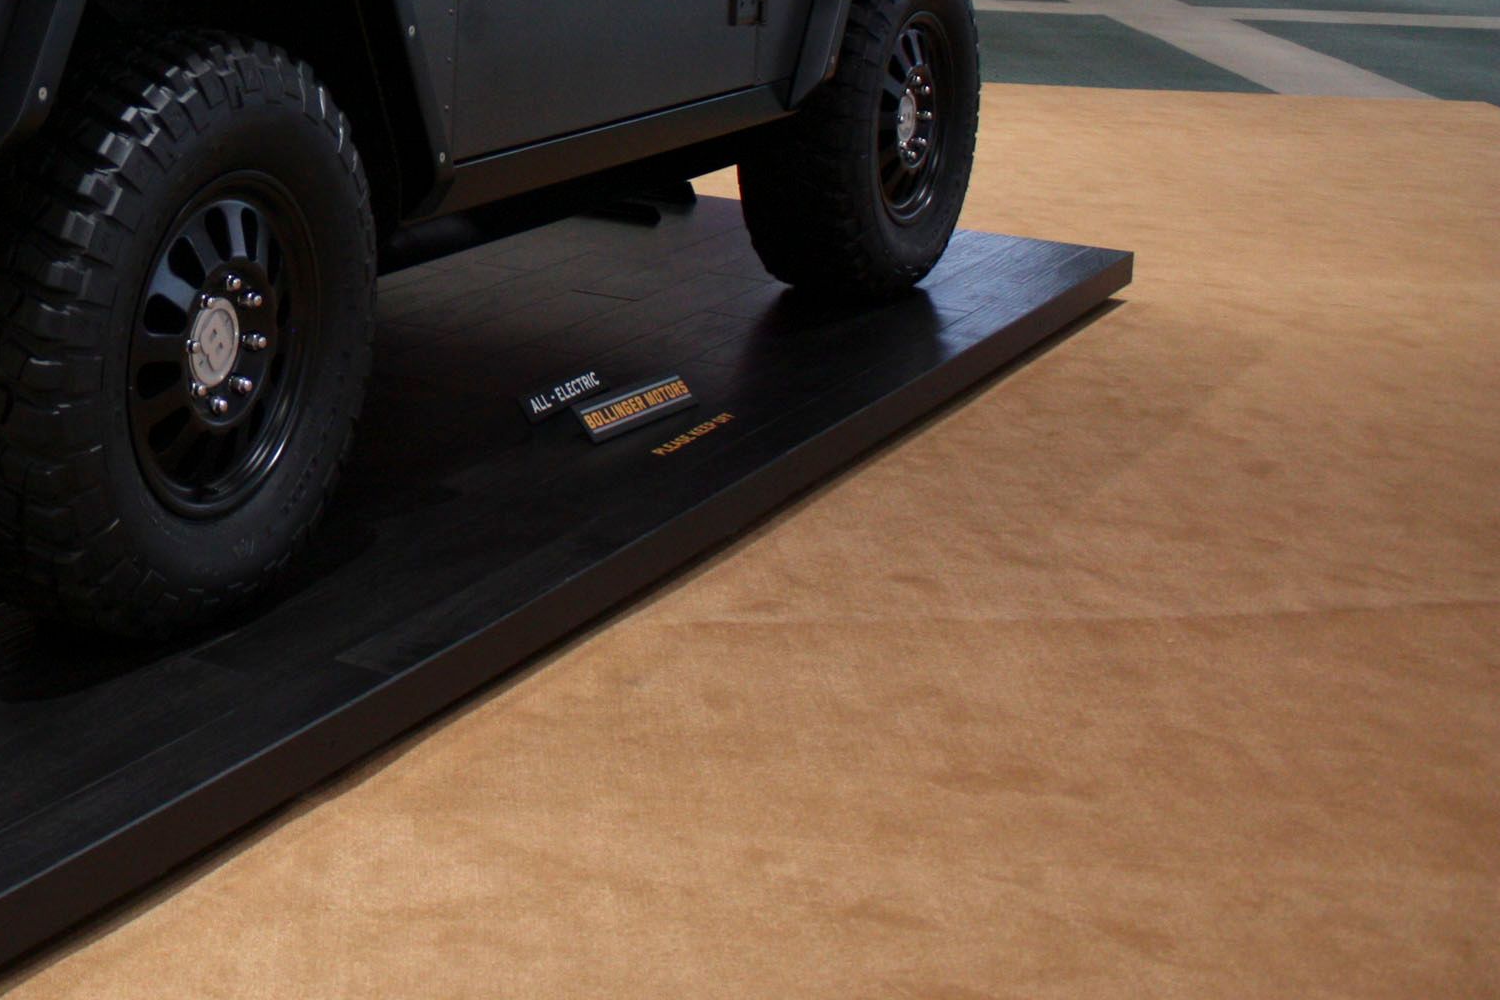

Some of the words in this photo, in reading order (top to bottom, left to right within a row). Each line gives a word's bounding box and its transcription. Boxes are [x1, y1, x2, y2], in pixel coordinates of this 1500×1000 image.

[530, 393, 552, 414] ALL
[554, 371, 600, 402] ELECTRIC
[583, 396, 646, 429] BOLLINGER
[644, 380, 689, 407] MOTORS
